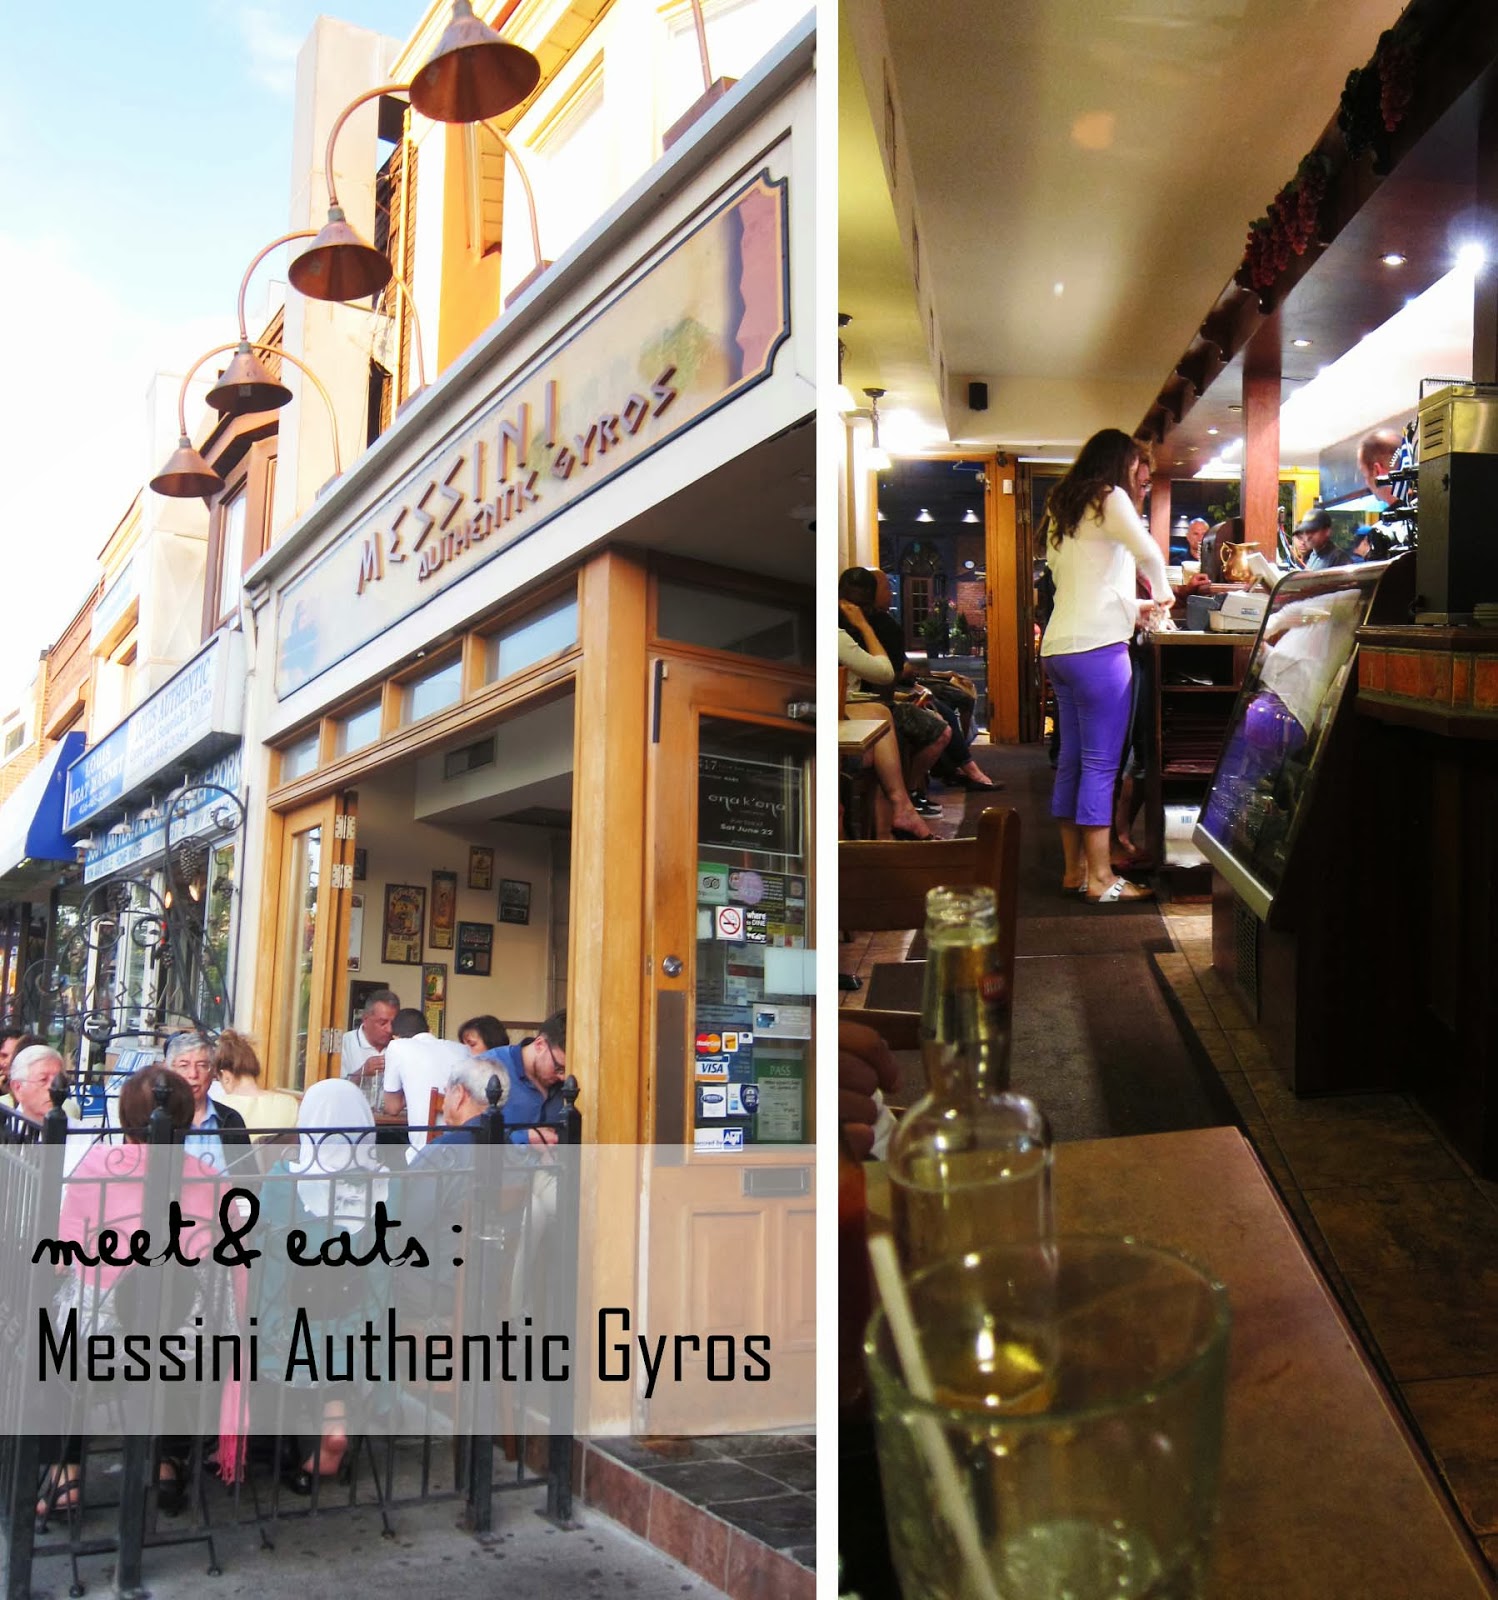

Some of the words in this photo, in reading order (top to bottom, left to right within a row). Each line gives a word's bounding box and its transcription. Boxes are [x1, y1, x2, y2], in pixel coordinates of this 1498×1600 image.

[552, 365, 677, 480] GYROS
[702, 1063, 723, 1073] VISA
[770, 1065, 791, 1076] PASS
